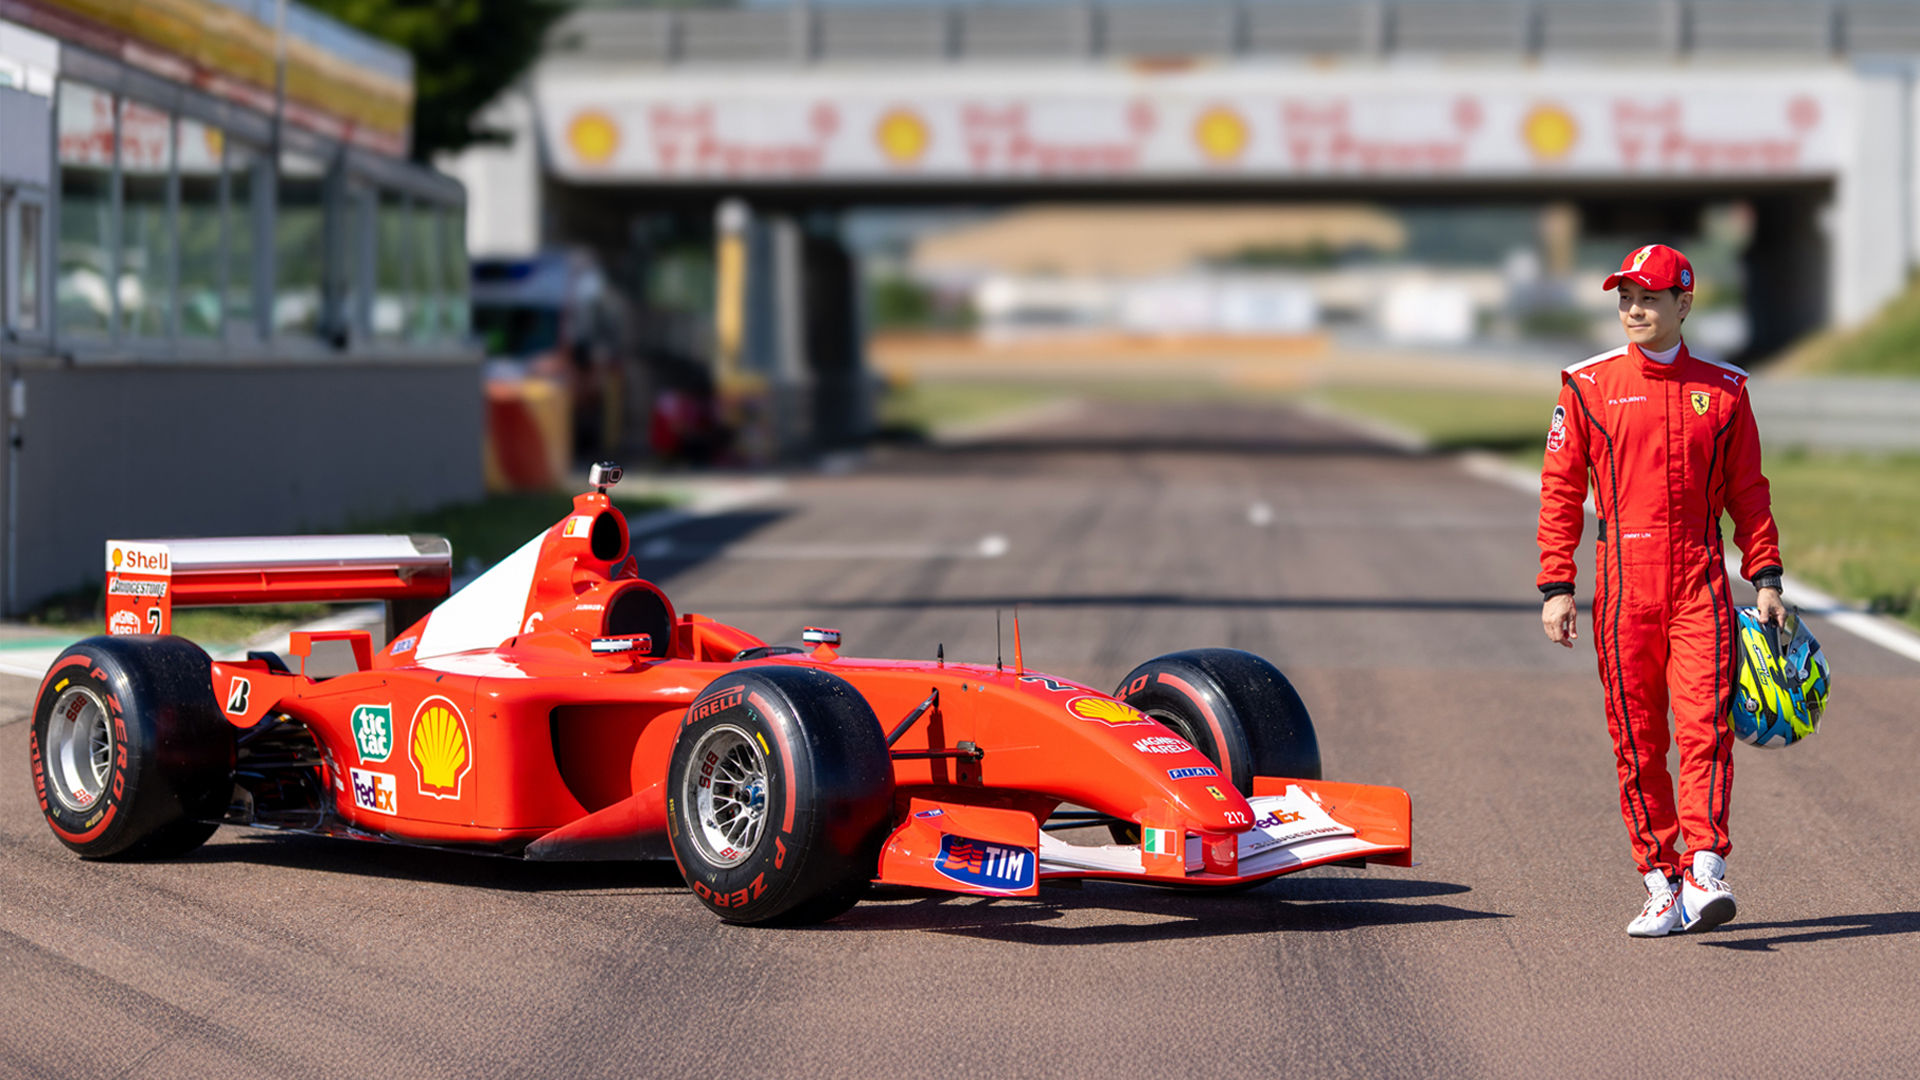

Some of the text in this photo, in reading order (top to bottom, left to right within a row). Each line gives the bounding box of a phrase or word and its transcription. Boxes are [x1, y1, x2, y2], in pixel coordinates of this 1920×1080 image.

[126, 550, 168, 570] Shell
[1115, 673, 1150, 702] RO
[687, 684, 745, 726] PIRELLI
[90, 667, 128, 801] P ZERO
[359, 708, 386, 735] tic
[358, 728, 388, 756] tac
[699, 751, 719, 789] BBS
[1170, 768, 1217, 780] FIAT
[352, 771, 395, 813] FedEx
[1224, 811, 1249, 824] 212
[1251, 809, 1307, 832] edEx
[694, 836, 787, 909] P ZERO
[985, 846, 1026, 882] TIM
